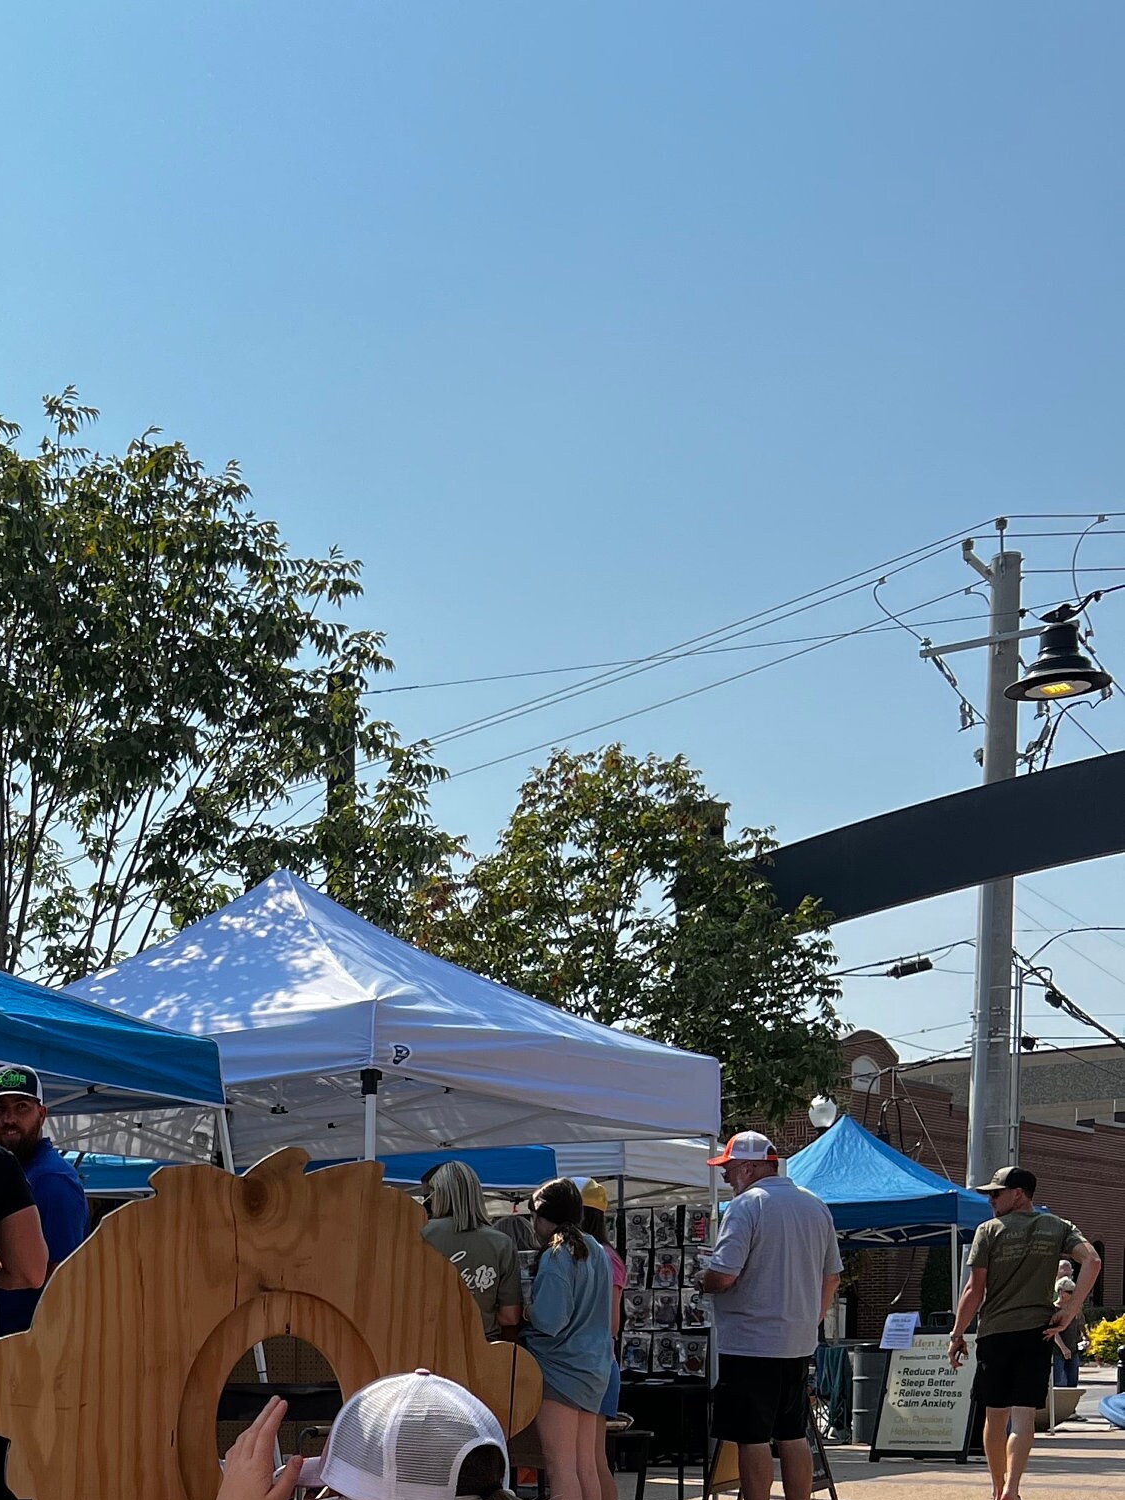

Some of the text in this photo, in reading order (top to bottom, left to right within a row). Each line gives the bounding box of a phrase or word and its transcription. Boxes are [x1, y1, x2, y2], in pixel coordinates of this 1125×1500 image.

[903, 1367, 958, 1376] Reduce Pain
[900, 1378, 956, 1388] Sleep Better
[898, 1388, 962, 1398] Relieve Stress
[897, 1398, 956, 1410] Calm Anxiety
